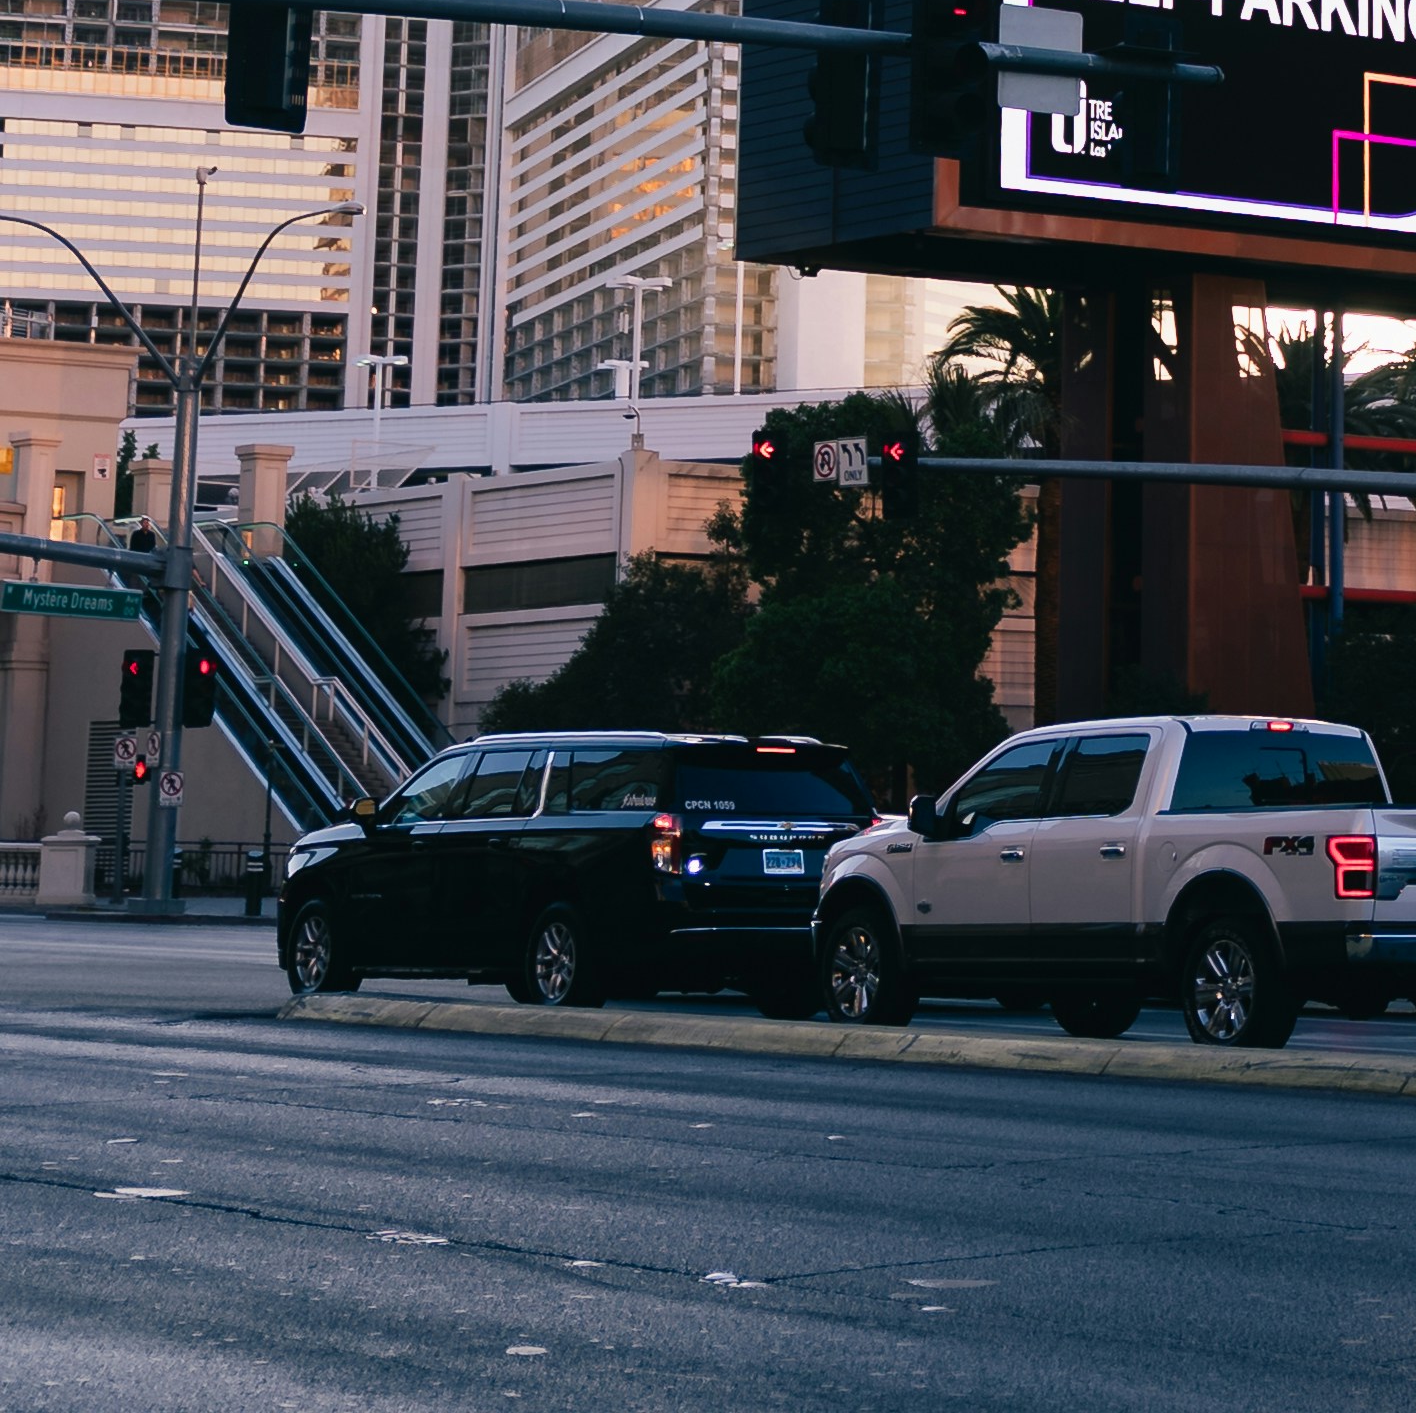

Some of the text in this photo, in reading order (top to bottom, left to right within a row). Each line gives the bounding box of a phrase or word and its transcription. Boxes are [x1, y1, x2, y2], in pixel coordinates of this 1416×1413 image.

[843, 469, 863, 482] ONLY
[23, 588, 68, 610] Mystère
[70, 591, 114, 612] Dreams
[685, 800, 736, 810] CPCN 1059
[1263, 835, 1315, 856] FX4
